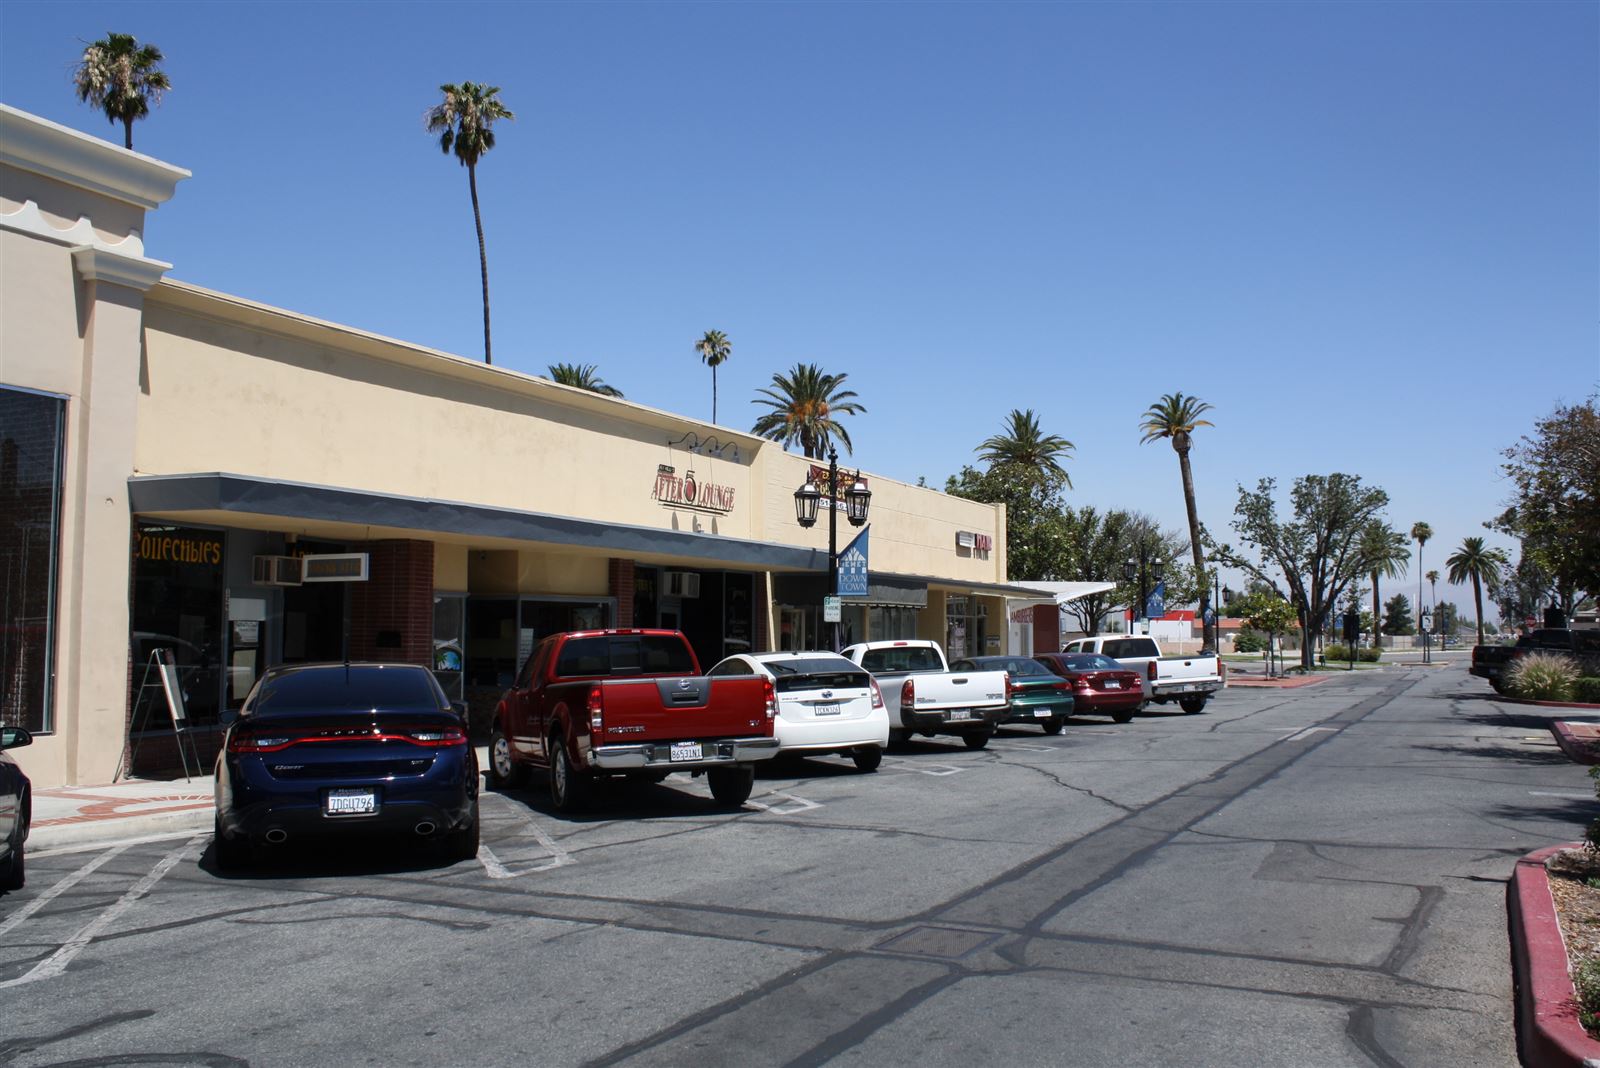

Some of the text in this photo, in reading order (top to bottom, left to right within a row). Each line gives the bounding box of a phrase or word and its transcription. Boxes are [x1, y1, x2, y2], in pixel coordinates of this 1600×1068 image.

[651, 470, 736, 512] AFTER 5 LOUNGE
[839, 574, 867, 583] DOWN
[840, 582, 867, 592] TOWN
[607, 725, 646, 734] FRONTIER
[330, 797, 373, 811] 7DGU796
